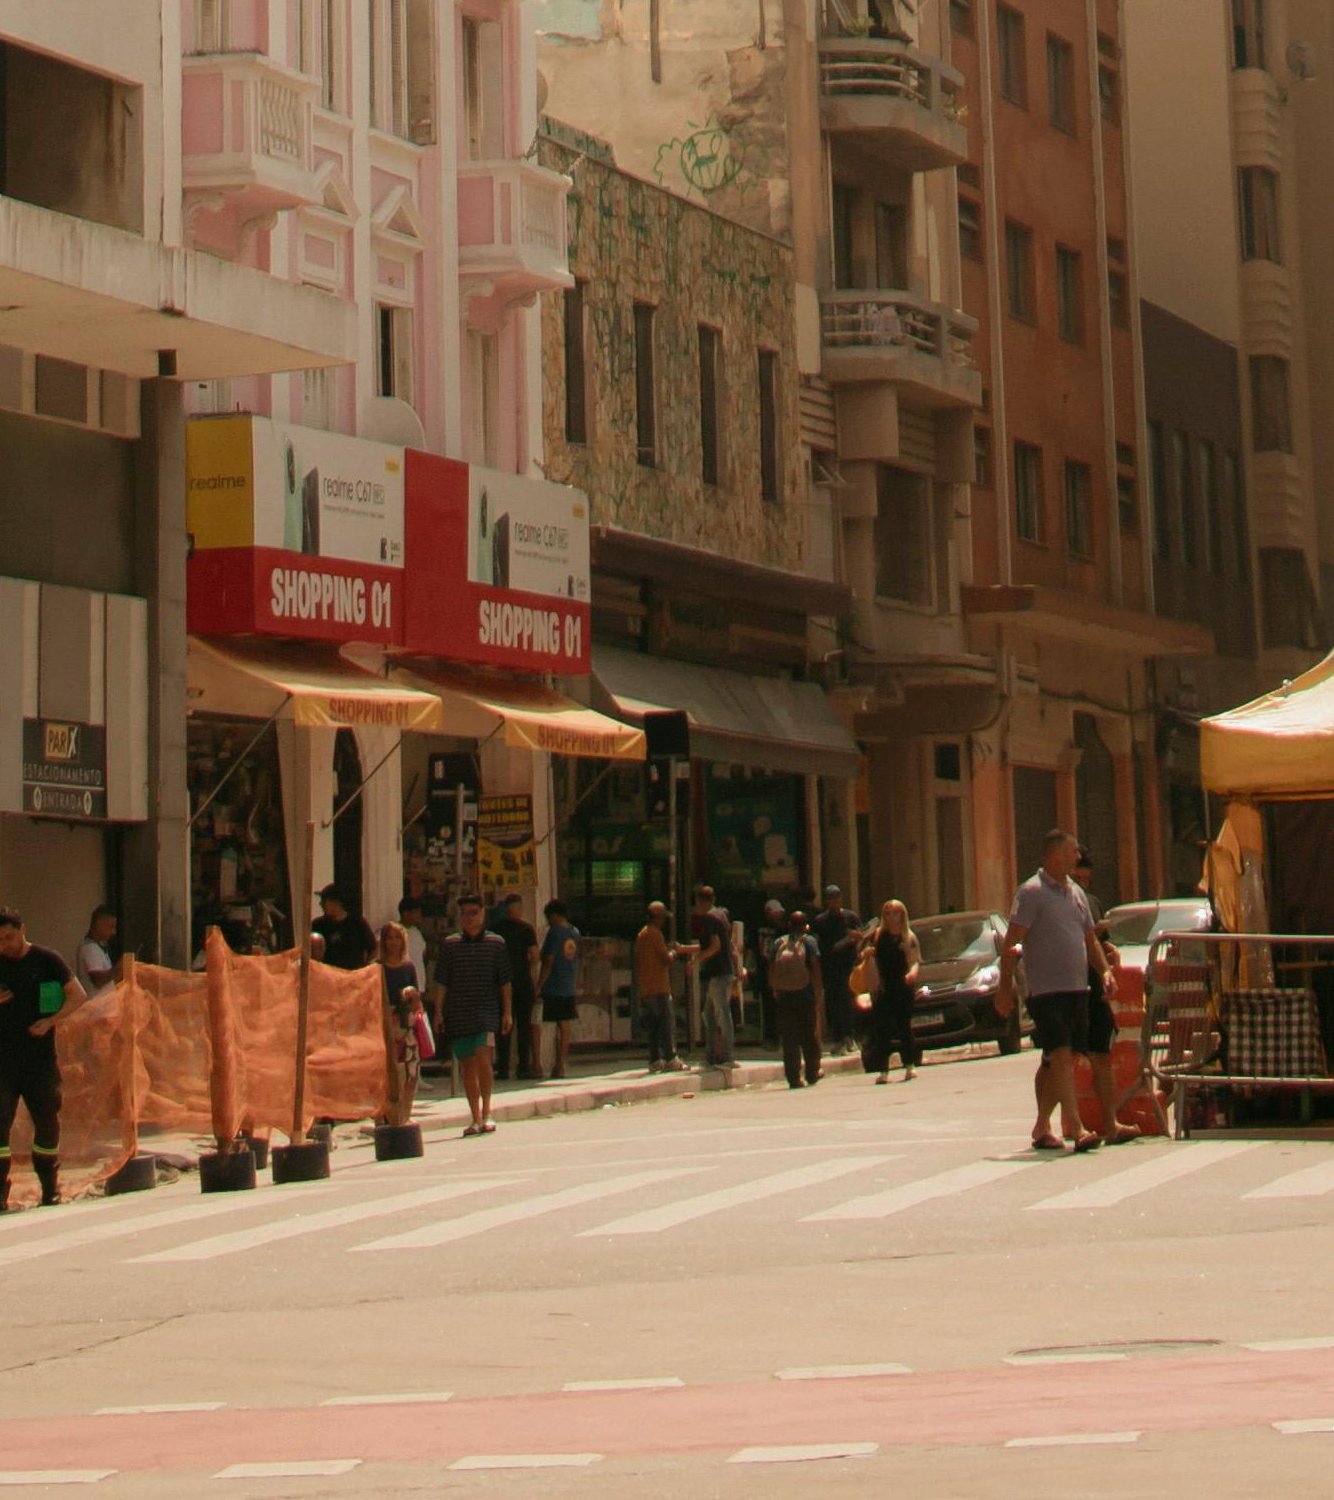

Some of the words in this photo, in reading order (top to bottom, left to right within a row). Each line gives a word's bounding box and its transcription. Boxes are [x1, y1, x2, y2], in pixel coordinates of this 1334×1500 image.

[189, 474, 246, 491] realme
[323, 476, 353, 500] realme
[514, 522, 541, 545] realme
[271, 568, 366, 625] SHOPPING
[371, 580, 391, 628] 01
[479, 600, 559, 654] SHOPPING
[565, 614, 581, 658] 01
[329, 698, 392, 724] SHOPPING
[537, 725, 600, 752] SHOPPING
[23, 763, 102, 785] ESTACIONAMENTO
[43, 792, 83, 810] ENTRADA
